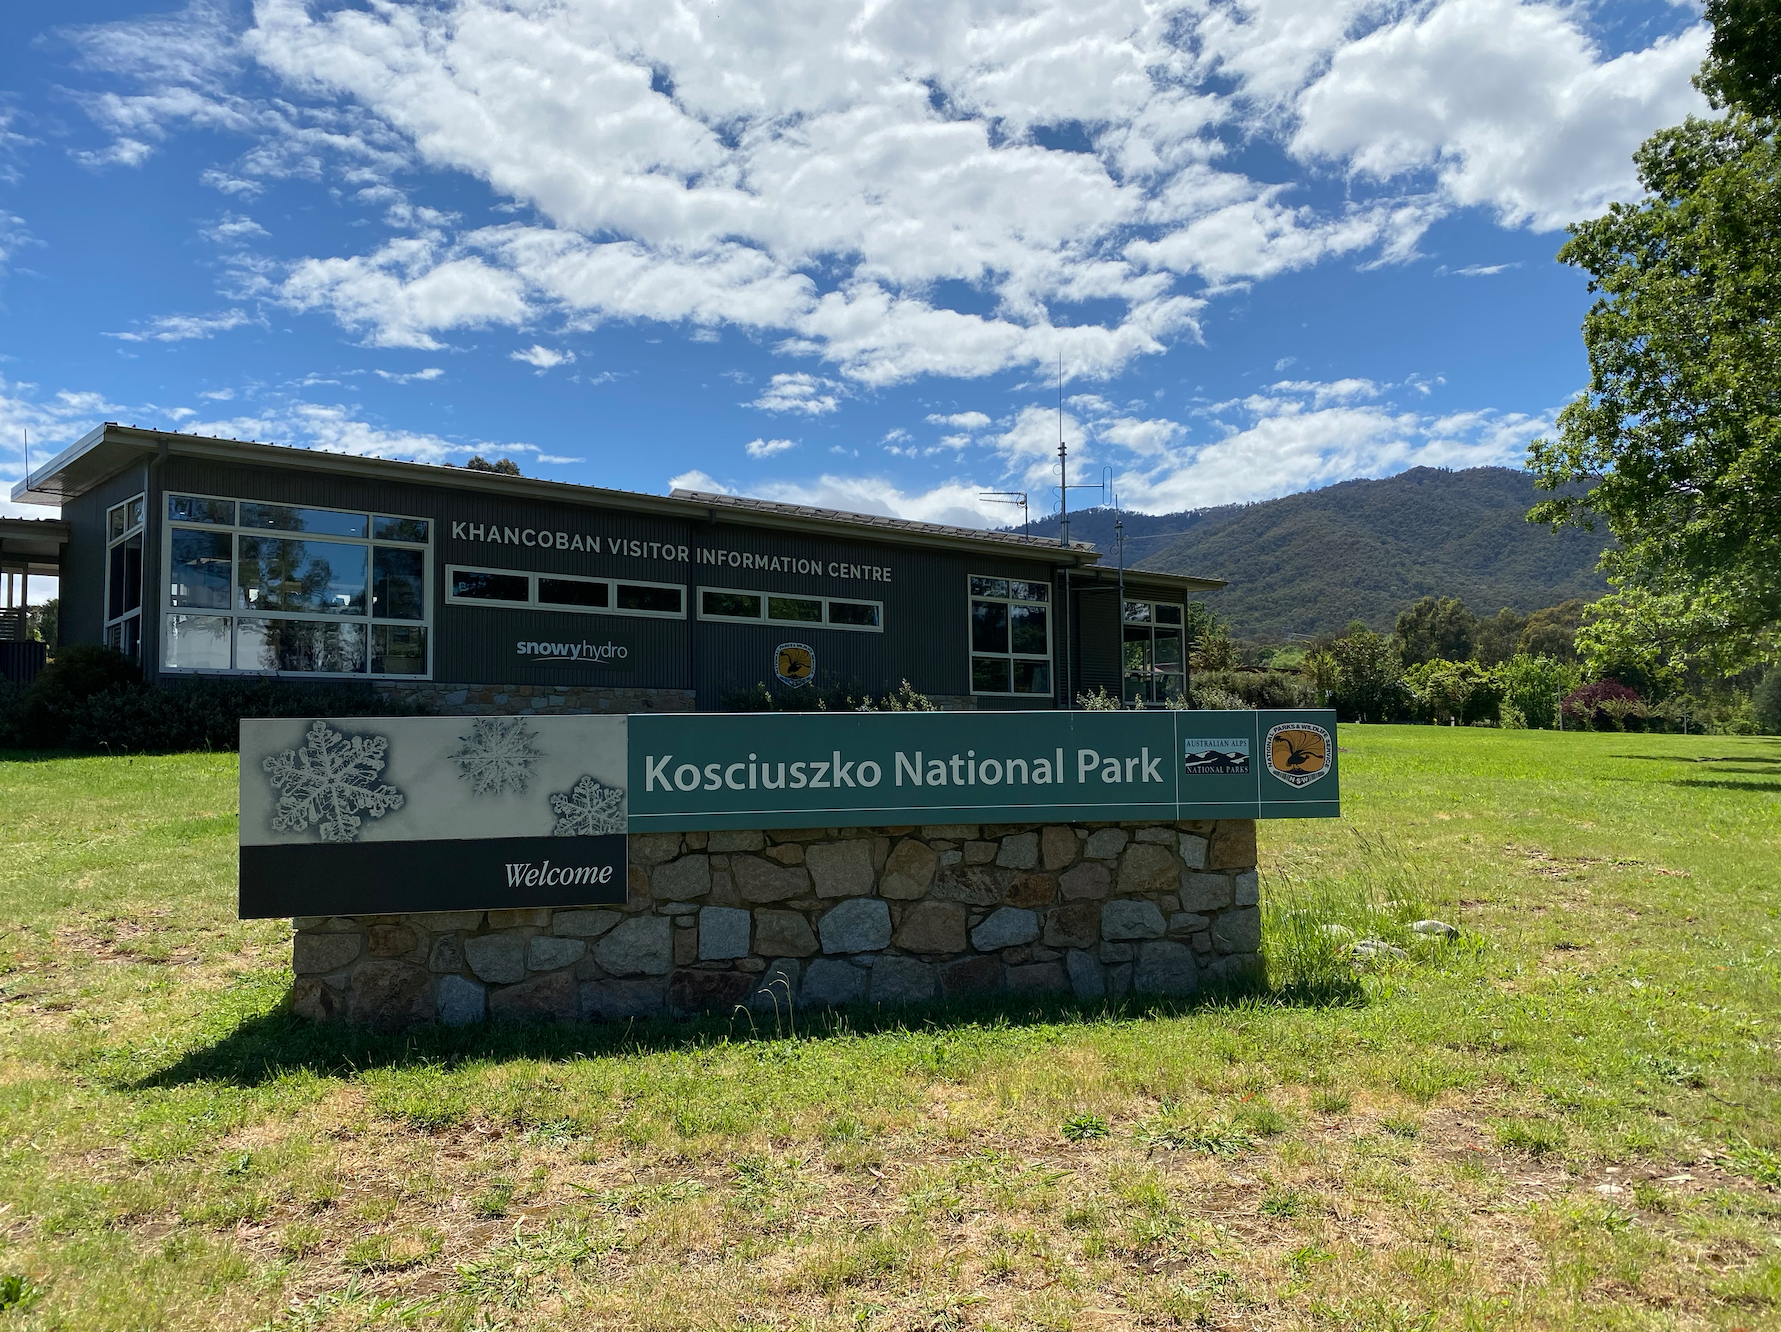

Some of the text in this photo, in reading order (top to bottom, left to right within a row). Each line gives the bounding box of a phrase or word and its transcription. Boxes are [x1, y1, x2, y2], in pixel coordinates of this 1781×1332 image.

[452, 520, 892, 582] KHANCOBAN VISITOR INFORMATION CENTRE
[516, 639, 628, 661] snowyhydro
[1266, 732, 1274, 768] NATIONAL
[1273, 724, 1295, 732] PARKS
[1301, 724, 1328, 738] WILDLIFE
[645, 747, 1164, 792] Kosciuszko National Park
[1186, 766, 1249, 774] NATIONAL PARKS
[505, 860, 613, 887] Welcome
